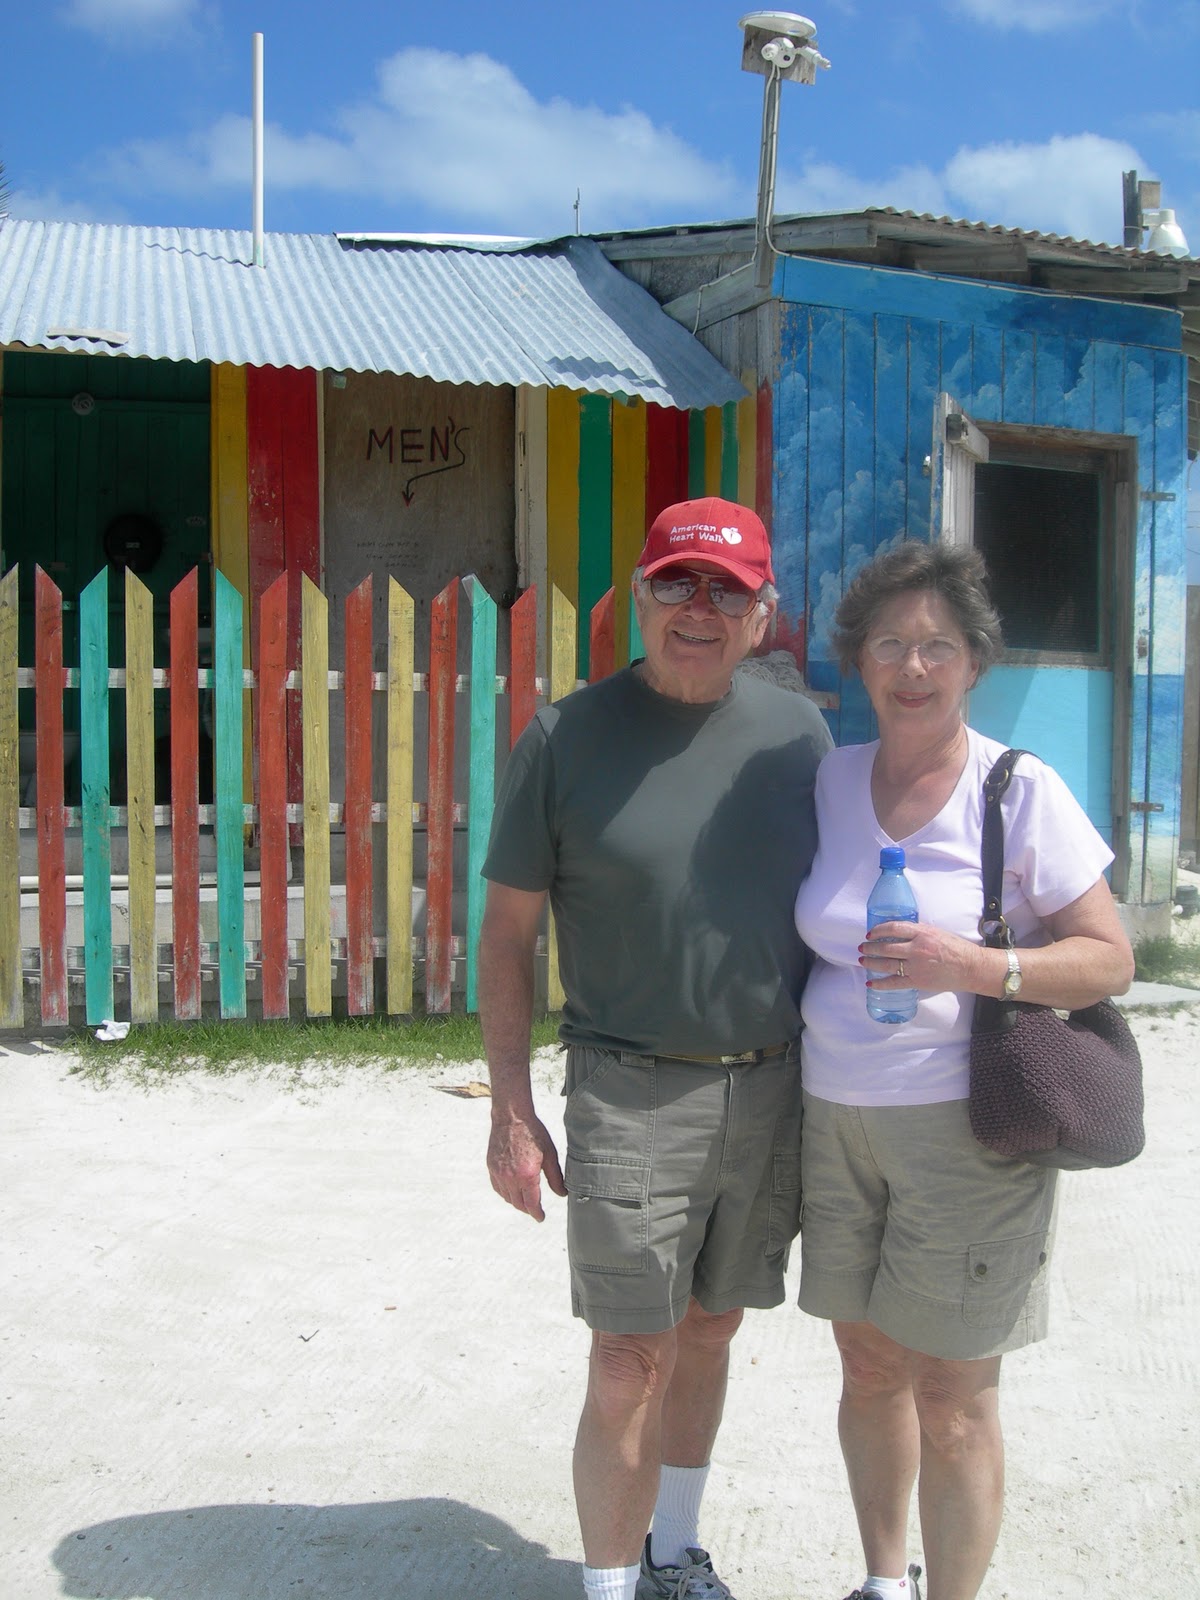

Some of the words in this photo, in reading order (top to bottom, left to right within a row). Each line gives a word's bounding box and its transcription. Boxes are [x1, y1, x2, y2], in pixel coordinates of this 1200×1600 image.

[366, 416, 470, 465] MEN'S
[670, 523, 717, 535] American
[669, 532, 695, 544] Heart
[698, 531, 724, 545] Walk
